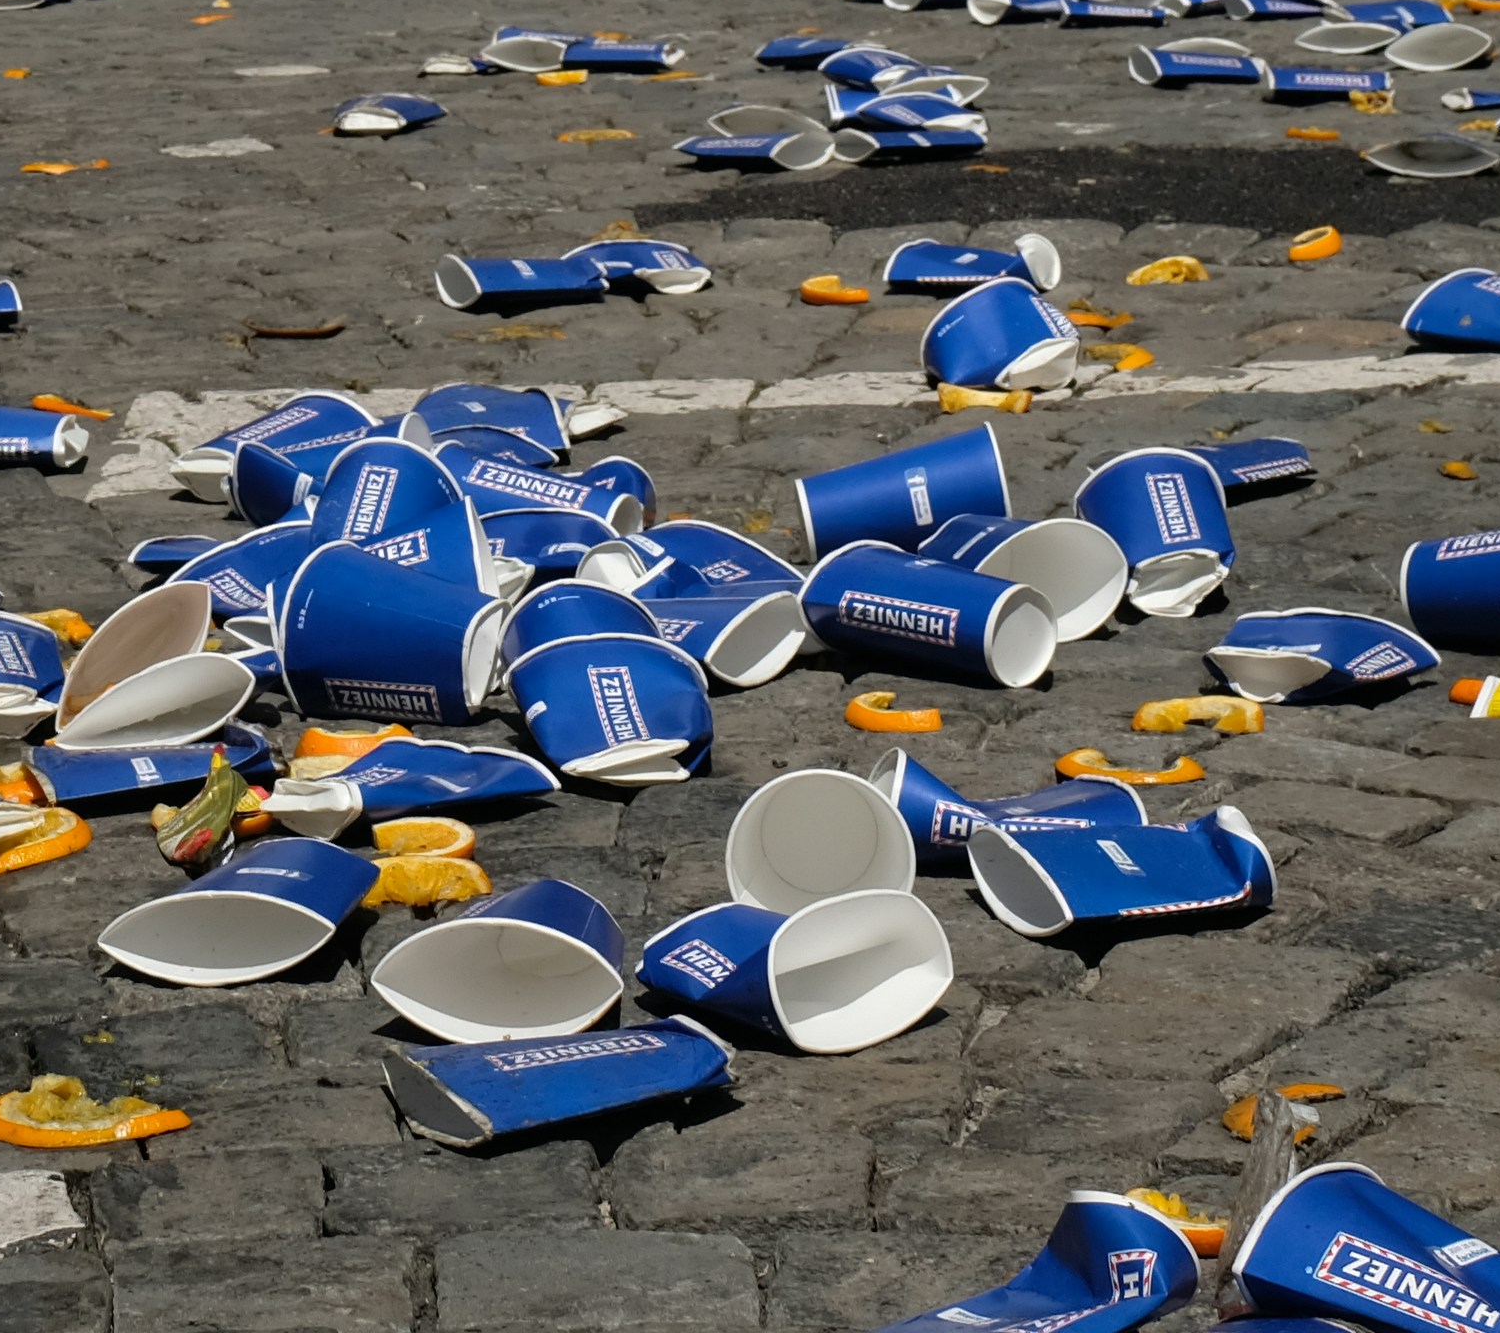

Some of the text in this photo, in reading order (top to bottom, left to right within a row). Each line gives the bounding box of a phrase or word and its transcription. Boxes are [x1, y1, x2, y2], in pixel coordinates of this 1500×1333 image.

[239, 410, 305, 441] HENNIEZ
[484, 467, 577, 501] HENNIEZ
[356, 474, 384, 536] HENNIEZ
[1159, 479, 1188, 537] HENNIEZ
[853, 602, 944, 633] HENNIEZ
[338, 689, 428, 712] HENNIEZ
[607, 675, 633, 741] HENNIEZ
[509, 1038, 644, 1066] HENNIEZ
[1342, 1251, 1500, 1327] HENNIEZ
